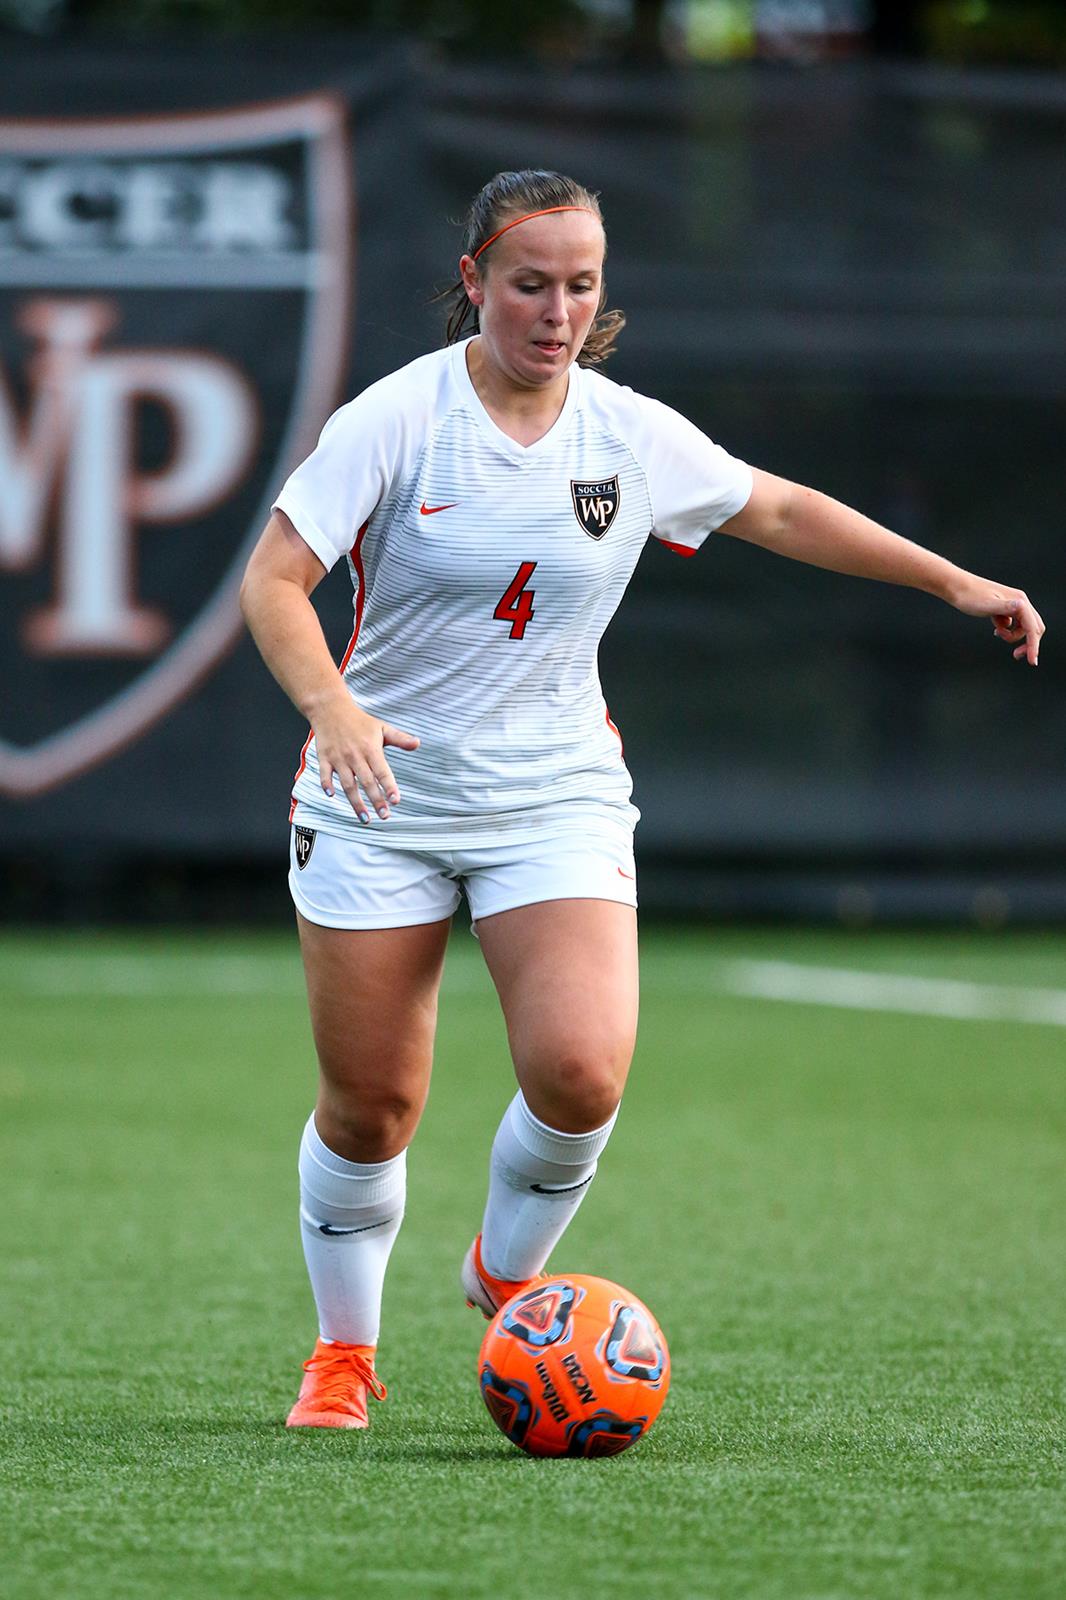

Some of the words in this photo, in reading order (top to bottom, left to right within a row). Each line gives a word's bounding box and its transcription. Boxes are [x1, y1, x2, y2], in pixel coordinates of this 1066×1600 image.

[577, 483, 613, 494] SOCCER
[579, 496, 614, 528] WP
[492, 561, 538, 640] 4
[535, 1361, 570, 1424] Wilson
[561, 1352, 598, 1405] NCAA
